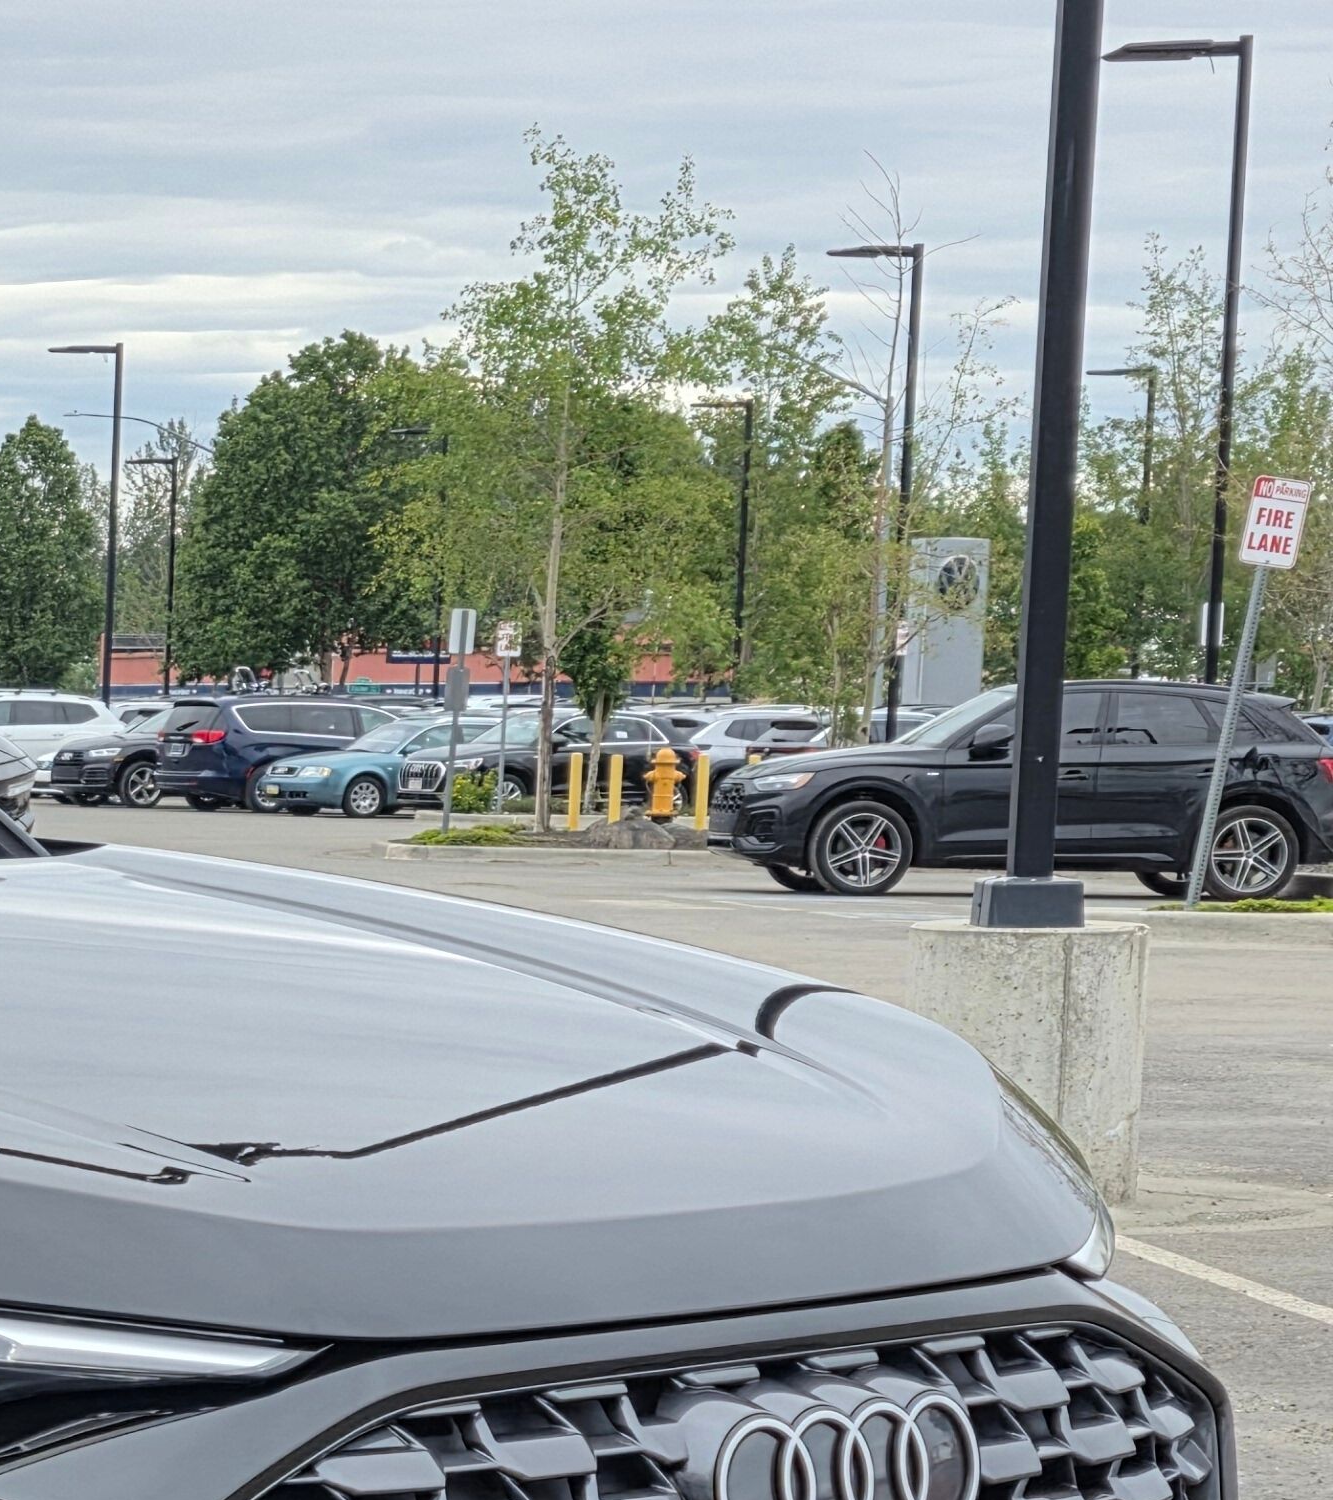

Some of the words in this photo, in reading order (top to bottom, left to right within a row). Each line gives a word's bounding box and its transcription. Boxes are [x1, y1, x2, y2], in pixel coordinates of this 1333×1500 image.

[1259, 480, 1274, 497] NO
[1275, 484, 1308, 499] PARKING
[1256, 507, 1295, 530] FIRE
[1247, 531, 1293, 555] LANE
